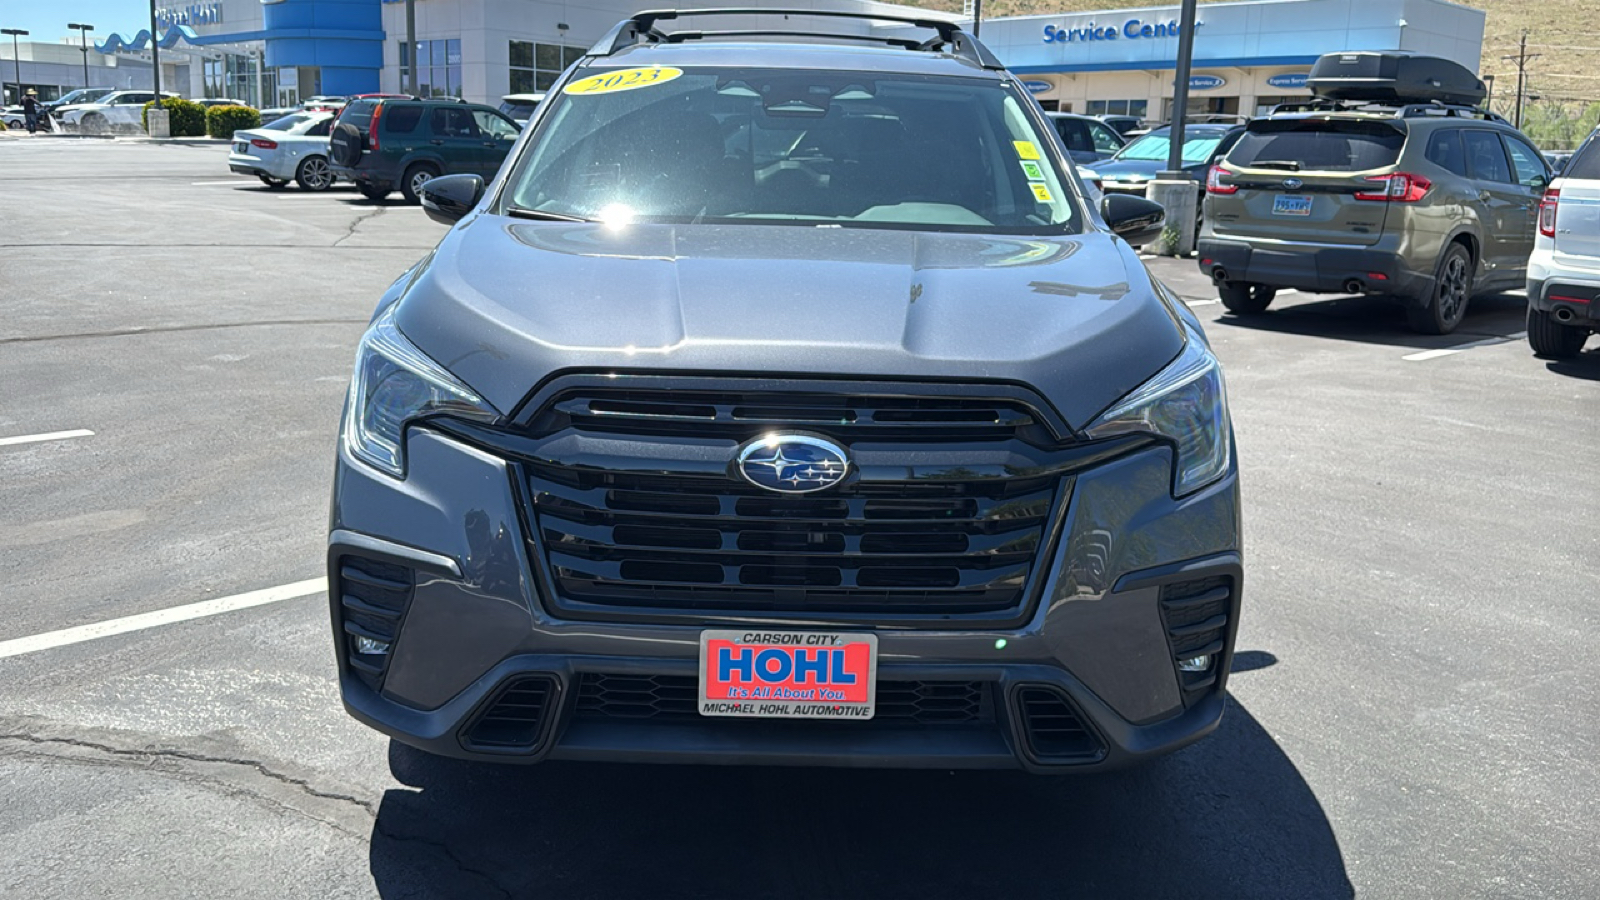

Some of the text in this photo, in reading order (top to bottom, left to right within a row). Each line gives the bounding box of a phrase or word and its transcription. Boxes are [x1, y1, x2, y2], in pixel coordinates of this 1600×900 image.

[1043, 22, 1117, 43] Service
[584, 68, 662, 92] 2023
[743, 633, 839, 646] CARSON CITY
[718, 647, 857, 685] HOHL
[727, 686, 748, 697] It's
[752, 687, 770, 697] All
[773, 687, 815, 699] About
[703, 703, 870, 716] MICHAEL HOHL AUTOMOTIVE
